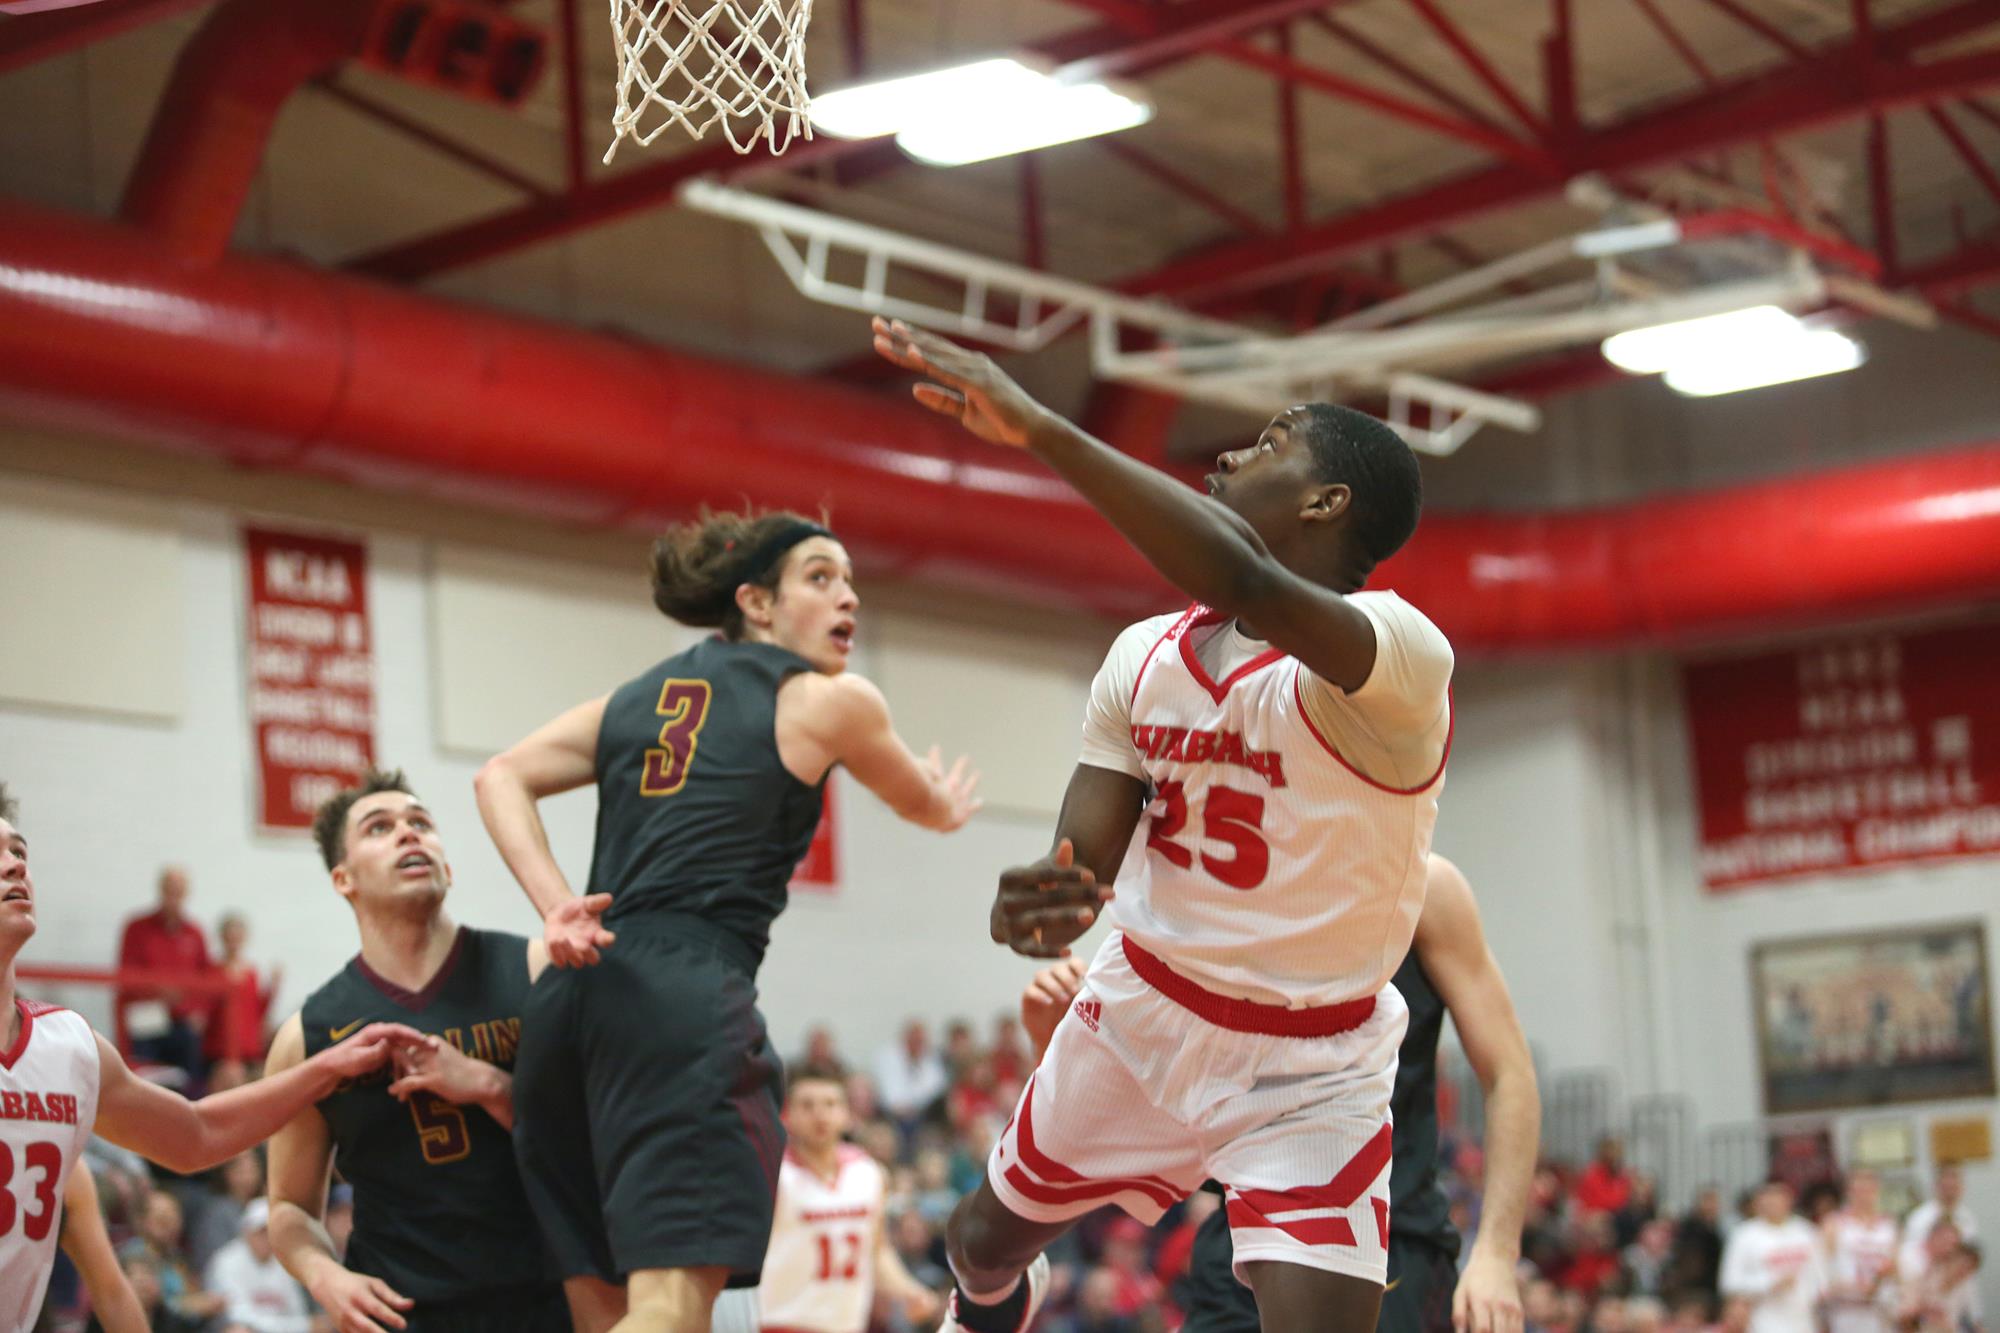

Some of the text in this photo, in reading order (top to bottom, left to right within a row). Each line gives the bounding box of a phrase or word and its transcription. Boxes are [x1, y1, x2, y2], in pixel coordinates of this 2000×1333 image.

[639, 678, 712, 797] 3
[1147, 777, 1270, 890] 25
[0, 1090, 78, 1125] BASH
[409, 1092, 471, 1165] 5
